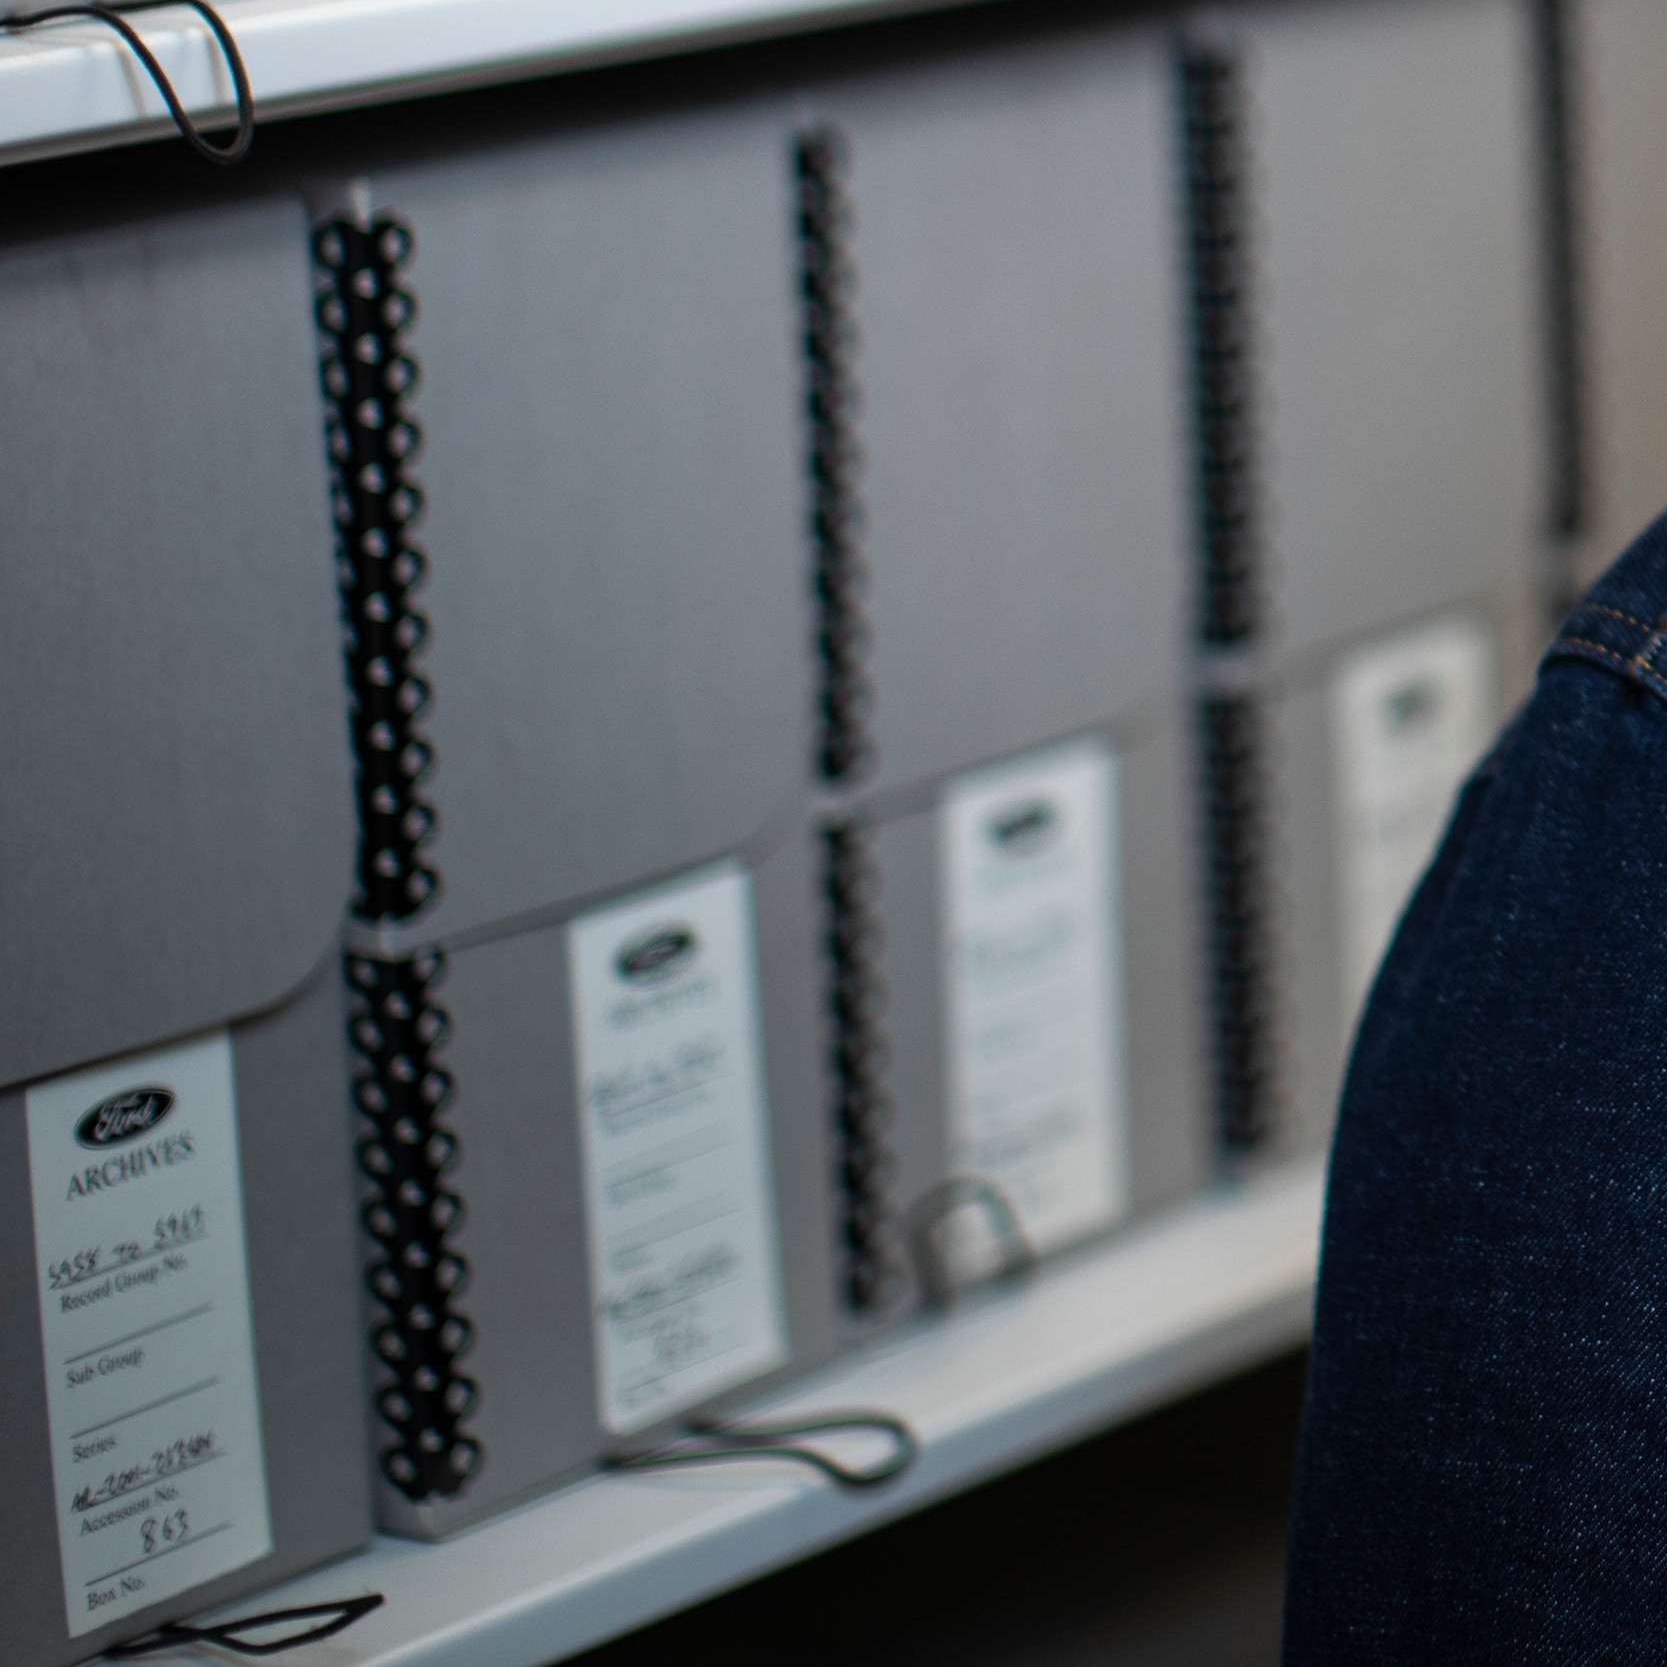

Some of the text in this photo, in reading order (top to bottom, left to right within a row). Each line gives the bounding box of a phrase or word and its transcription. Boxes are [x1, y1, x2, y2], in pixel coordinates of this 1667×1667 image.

[65, 1129, 196, 1201] ARCHIVES
[61, 1277, 114, 1314] Record
[115, 1265, 160, 1293] Group
[66, 1347, 145, 1389] Sub Group
[72, 1436, 118, 1463] Series
[80, 1496, 151, 1536] Accession
[86, 1587, 117, 1612] Box
